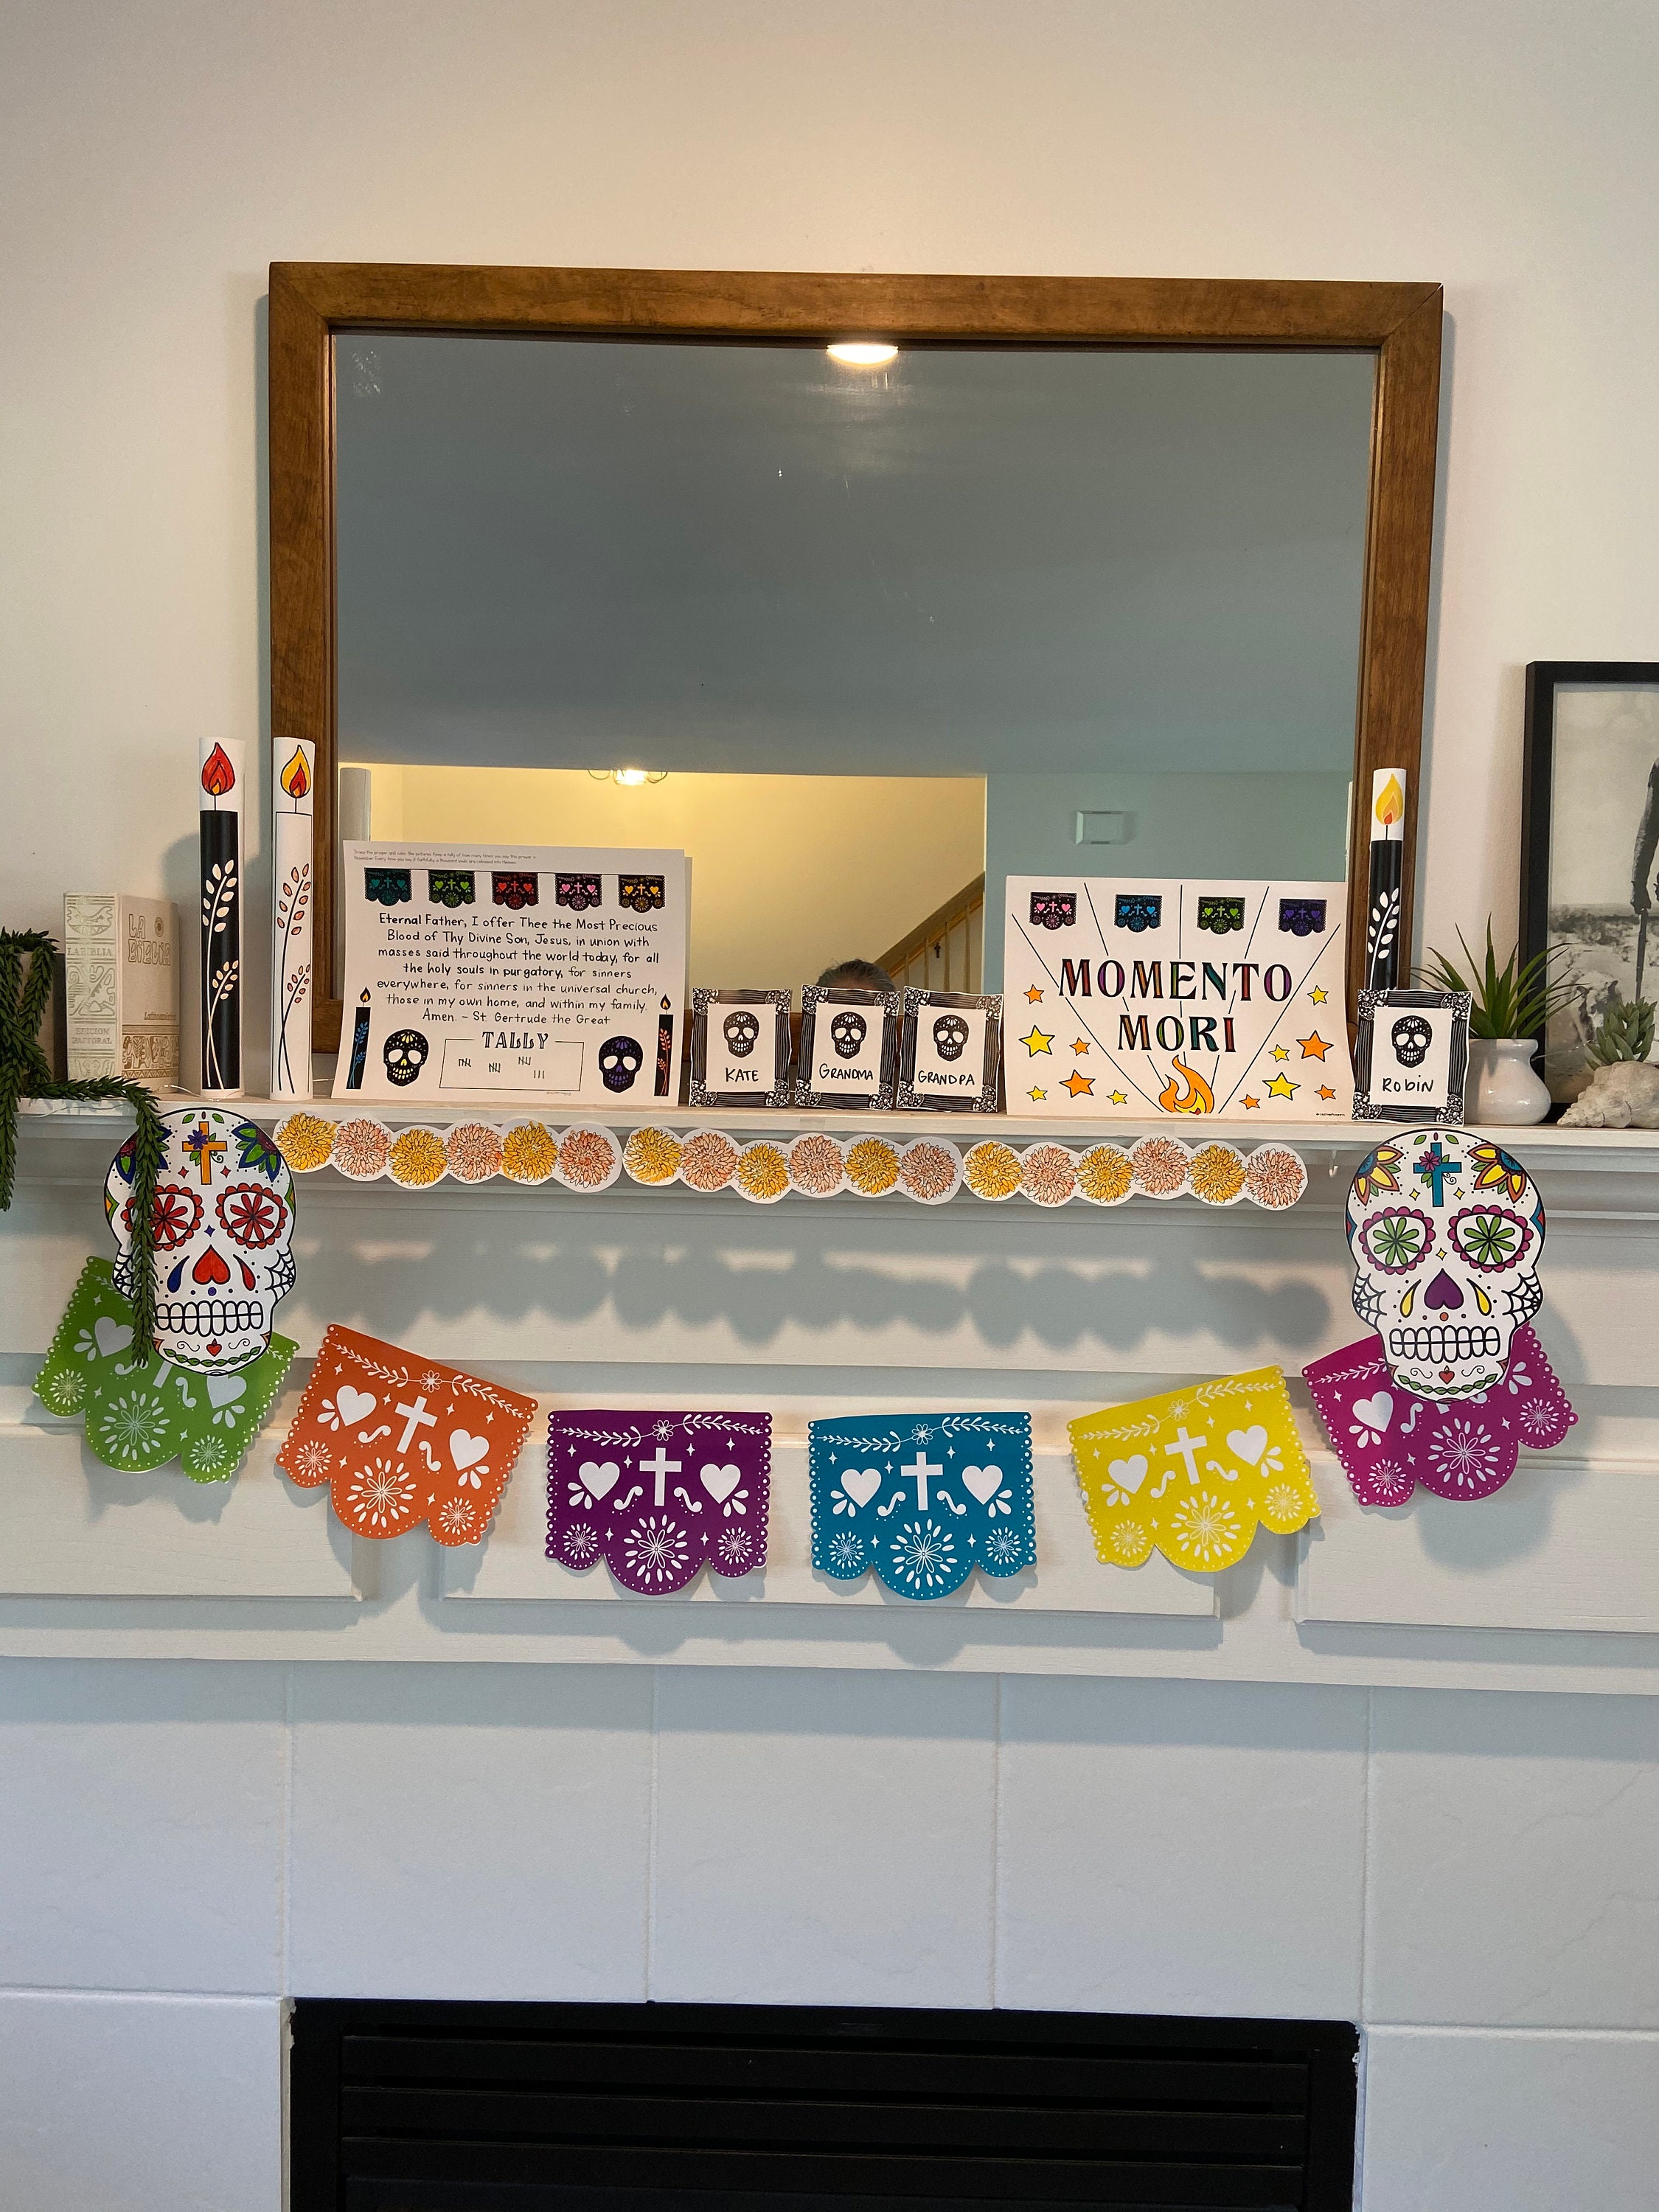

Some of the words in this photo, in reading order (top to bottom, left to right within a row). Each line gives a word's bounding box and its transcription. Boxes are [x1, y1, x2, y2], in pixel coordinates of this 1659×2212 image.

[128, 914, 146, 939] LA
[379, 912, 422, 925] Eternal
[425, 914, 467, 928] Father,
[471, 916, 479, 926] I
[482, 916, 515, 928] offer
[519, 917, 549, 929] Thee
[552, 918, 572, 930] the
[576, 918, 606, 931] Most
[608, 918, 658, 933] Precious
[387, 928, 420, 941] Blood
[424, 931, 439, 942] of
[442, 931, 464, 946] Thy
[468, 931, 502, 945] Divine
[505, 932, 530, 946] Son,
[535, 933, 571, 946] Jesus,
[576, 936, 585, 947] in
[589, 938, 620, 947] union
[623, 936, 650, 947] with
[378, 948, 421, 957] masses
[425, 946, 450, 958] said
[452, 947, 518, 962] throughout
[521, 949, 542, 961] the
[546, 950, 580, 962] world
[581, 950, 618, 967] today,
[622, 951, 641, 964] for
[646, 952, 659, 964] all
[403, 961, 423, 973] the
[427, 961, 451, 976] holy
[456, 964, 484, 975] souls
[489, 966, 499, 975] in
[568, 965, 586, 978] for
[592, 968, 632, 978] sinners
[377, 978, 449, 992] everywhere,
[453, 978, 473, 990] for
[477, 981, 518, 992] sinners
[523, 983, 533, 992] in
[536, 981, 556, 992] the
[560, 984, 611, 994] universal
[616, 983, 658, 996] church,
[1059, 959, 1293, 1001] MOMENTO
[386, 992, 420, 1005] those
[423, 998, 434, 1006] in
[438, 998, 456, 1009] my
[459, 998, 482, 1006] own
[487, 995, 519, 1009] home,
[525, 996, 546, 1009] and
[549, 998, 585, 1009] within
[588, 1001, 606, 1012] my
[494, 1012, 547, 1024] Gertrude
[551, 1013, 571, 1025] the
[576, 1014, 611, 1025] Great
[481, 1032, 549, 1049] TALLY
[1118, 1015, 1237, 1052] MORI
[725, 1067, 759, 1082] KATE
[818, 1062, 874, 1081] GRANDMA
[917, 1070, 975, 1086] GRANDPA
